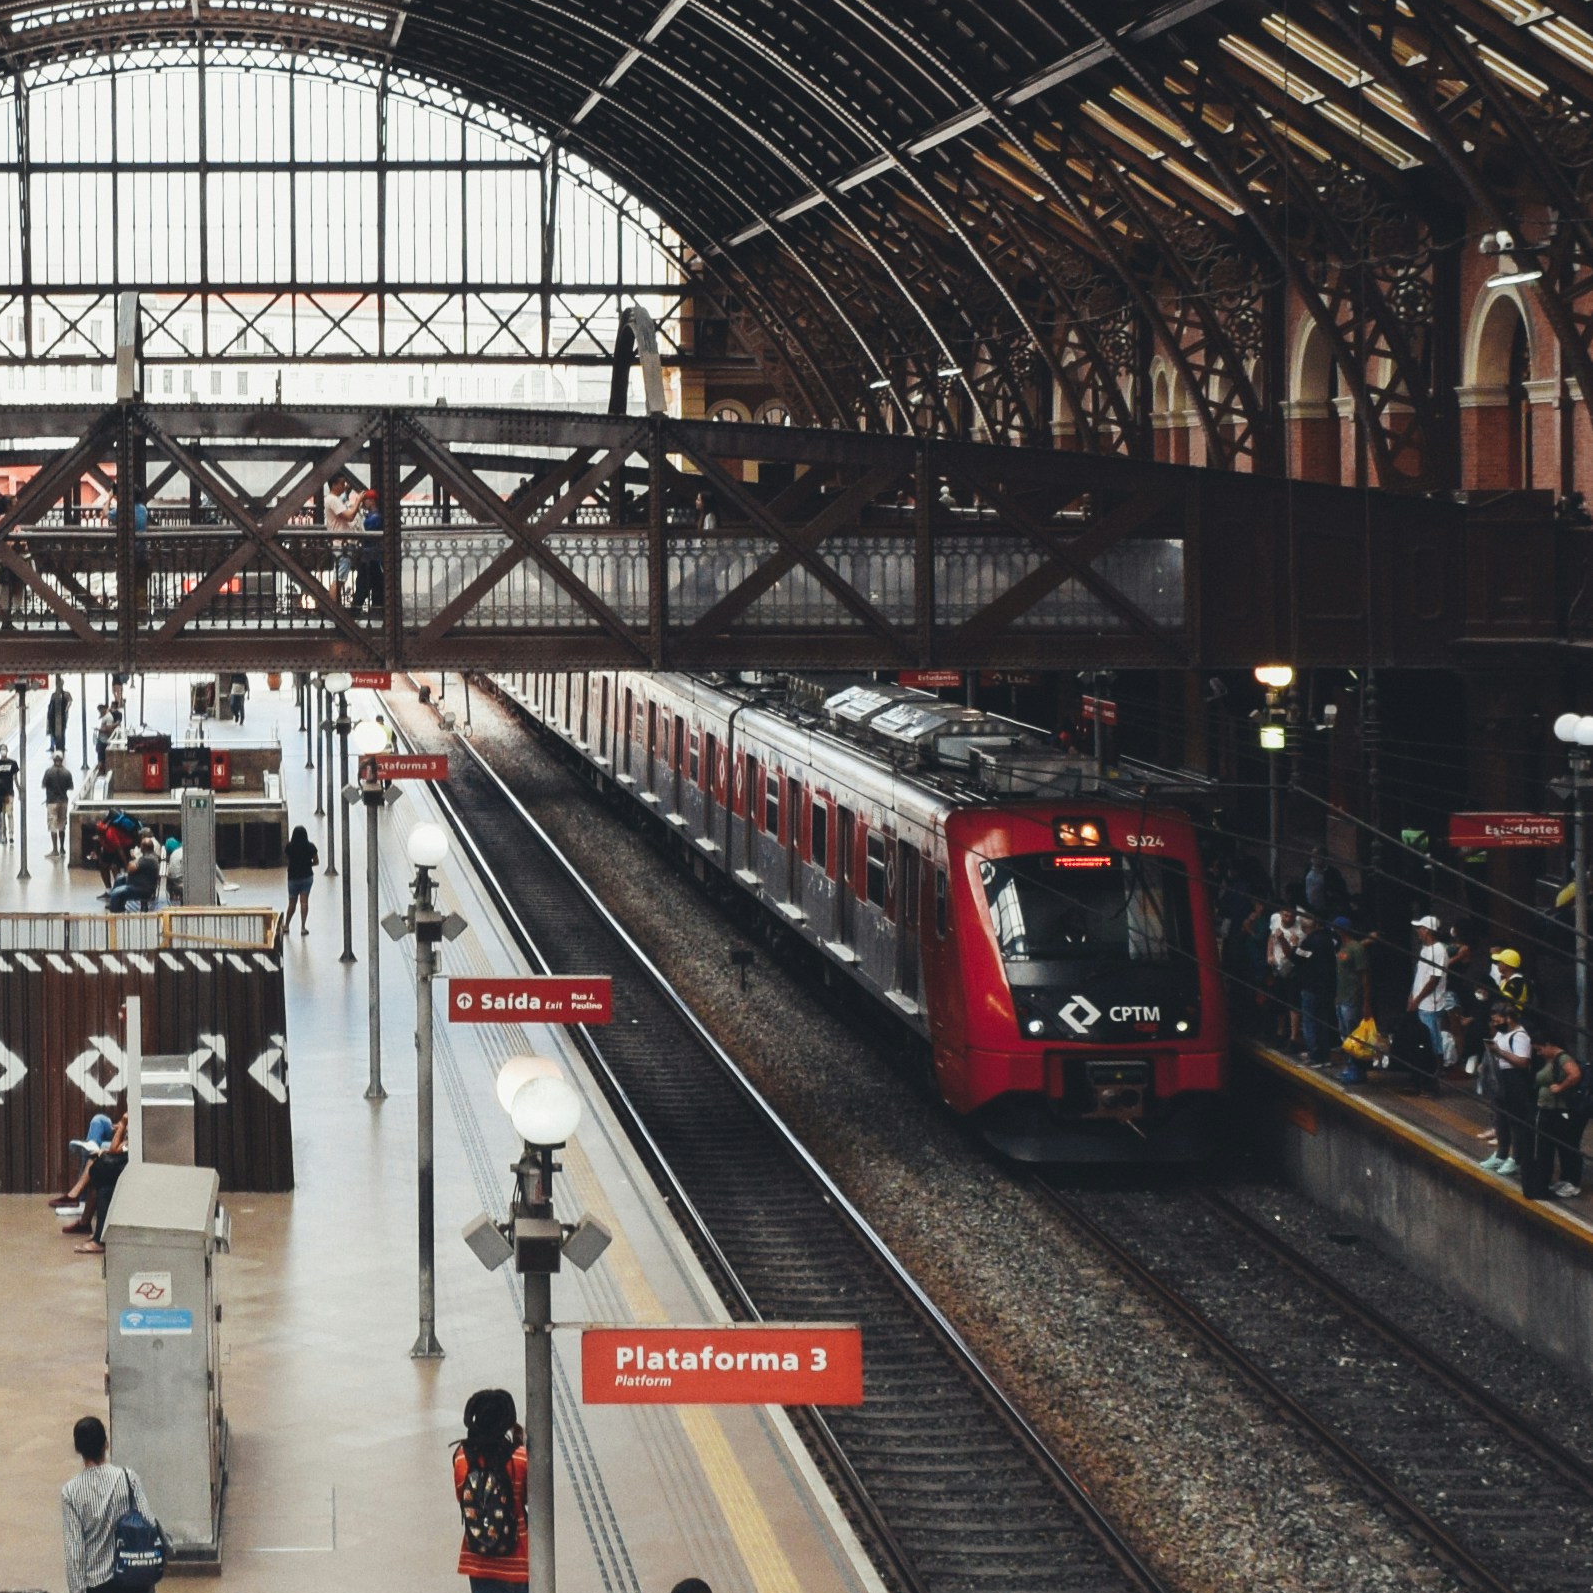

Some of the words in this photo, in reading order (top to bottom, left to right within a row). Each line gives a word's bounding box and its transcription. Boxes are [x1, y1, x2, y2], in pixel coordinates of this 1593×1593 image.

[377, 761, 427, 771] taforma
[430, 761, 437, 770] 3
[1485, 824, 1560, 836] Estudantes
[480, 992, 541, 1010] Saída
[545, 1001, 563, 1010] Exit
[571, 992, 587, 1001] Rua
[571, 1002, 603, 1011] Paulino
[1109, 1006, 1161, 1022] CPTM
[616, 1345, 799, 1372] Plataforma
[810, 1348, 828, 1372] 3
[614, 1374, 672, 1387] Platform
